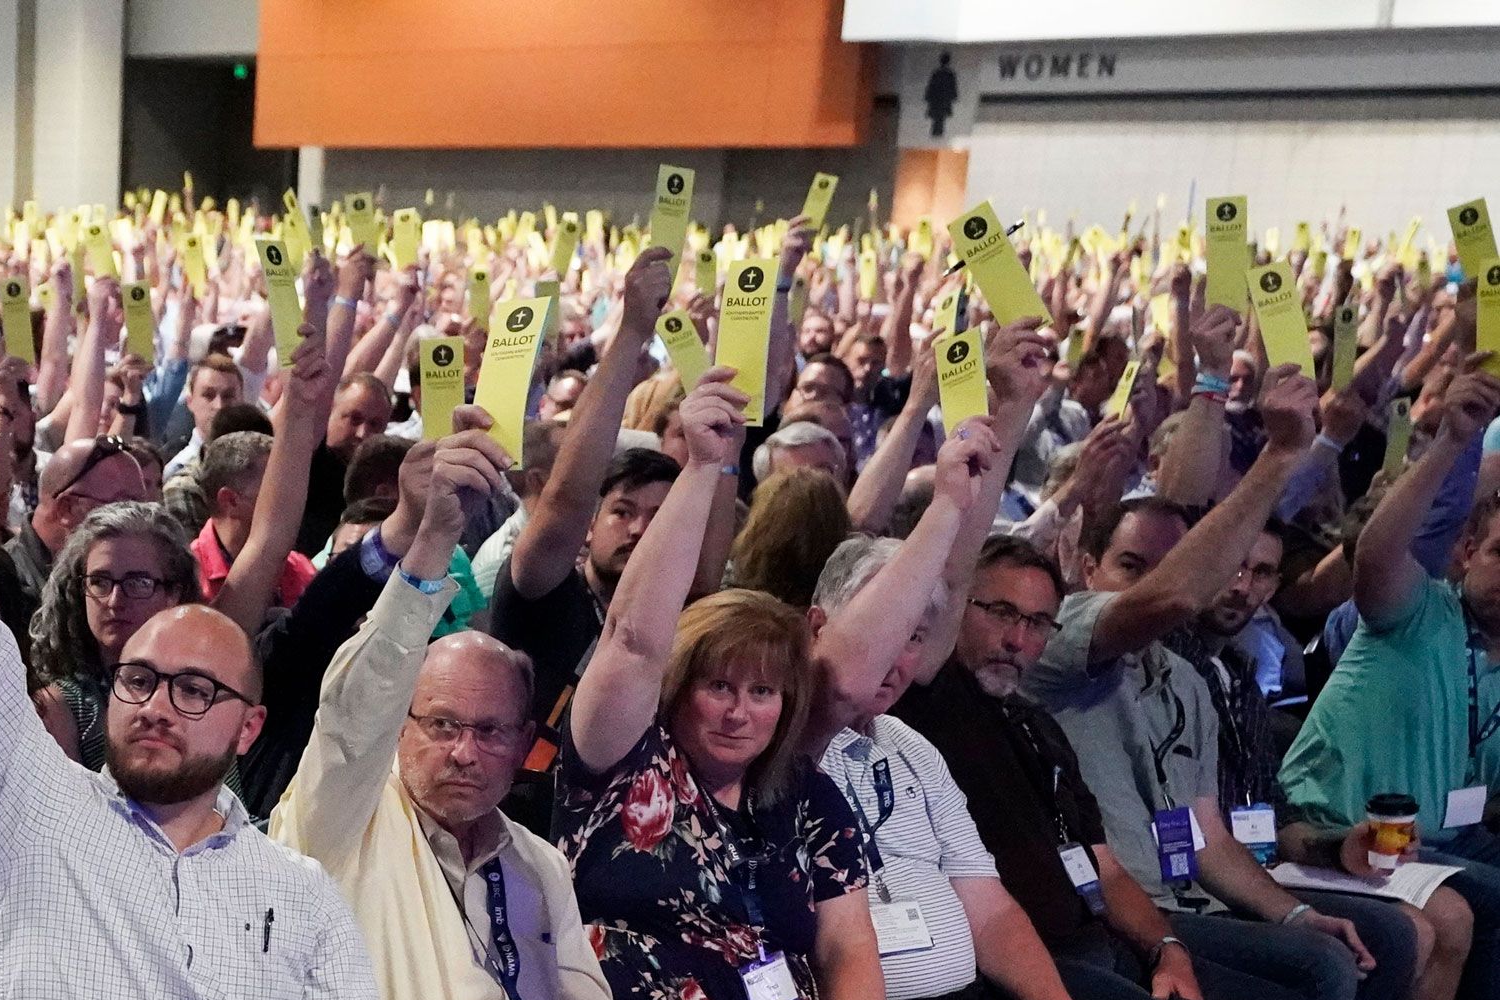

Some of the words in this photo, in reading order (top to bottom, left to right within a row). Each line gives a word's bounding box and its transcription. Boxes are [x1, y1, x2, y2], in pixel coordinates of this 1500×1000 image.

[999, 53, 1116, 80] WOMEN
[1210, 224, 1242, 233] BALLOT
[965, 231, 1002, 258] BALLOT
[726, 296, 768, 307] BALLOT
[1257, 290, 1292, 308] BALLOT
[491, 334, 536, 349] BALLOT
[425, 368, 461, 379] BALLOT
[941, 358, 978, 381] BALLOT
[883, 790, 892, 808] imb
[728, 843, 740, 861] imb
[494, 906, 505, 925] imb
[505, 952, 517, 978] NAMB
